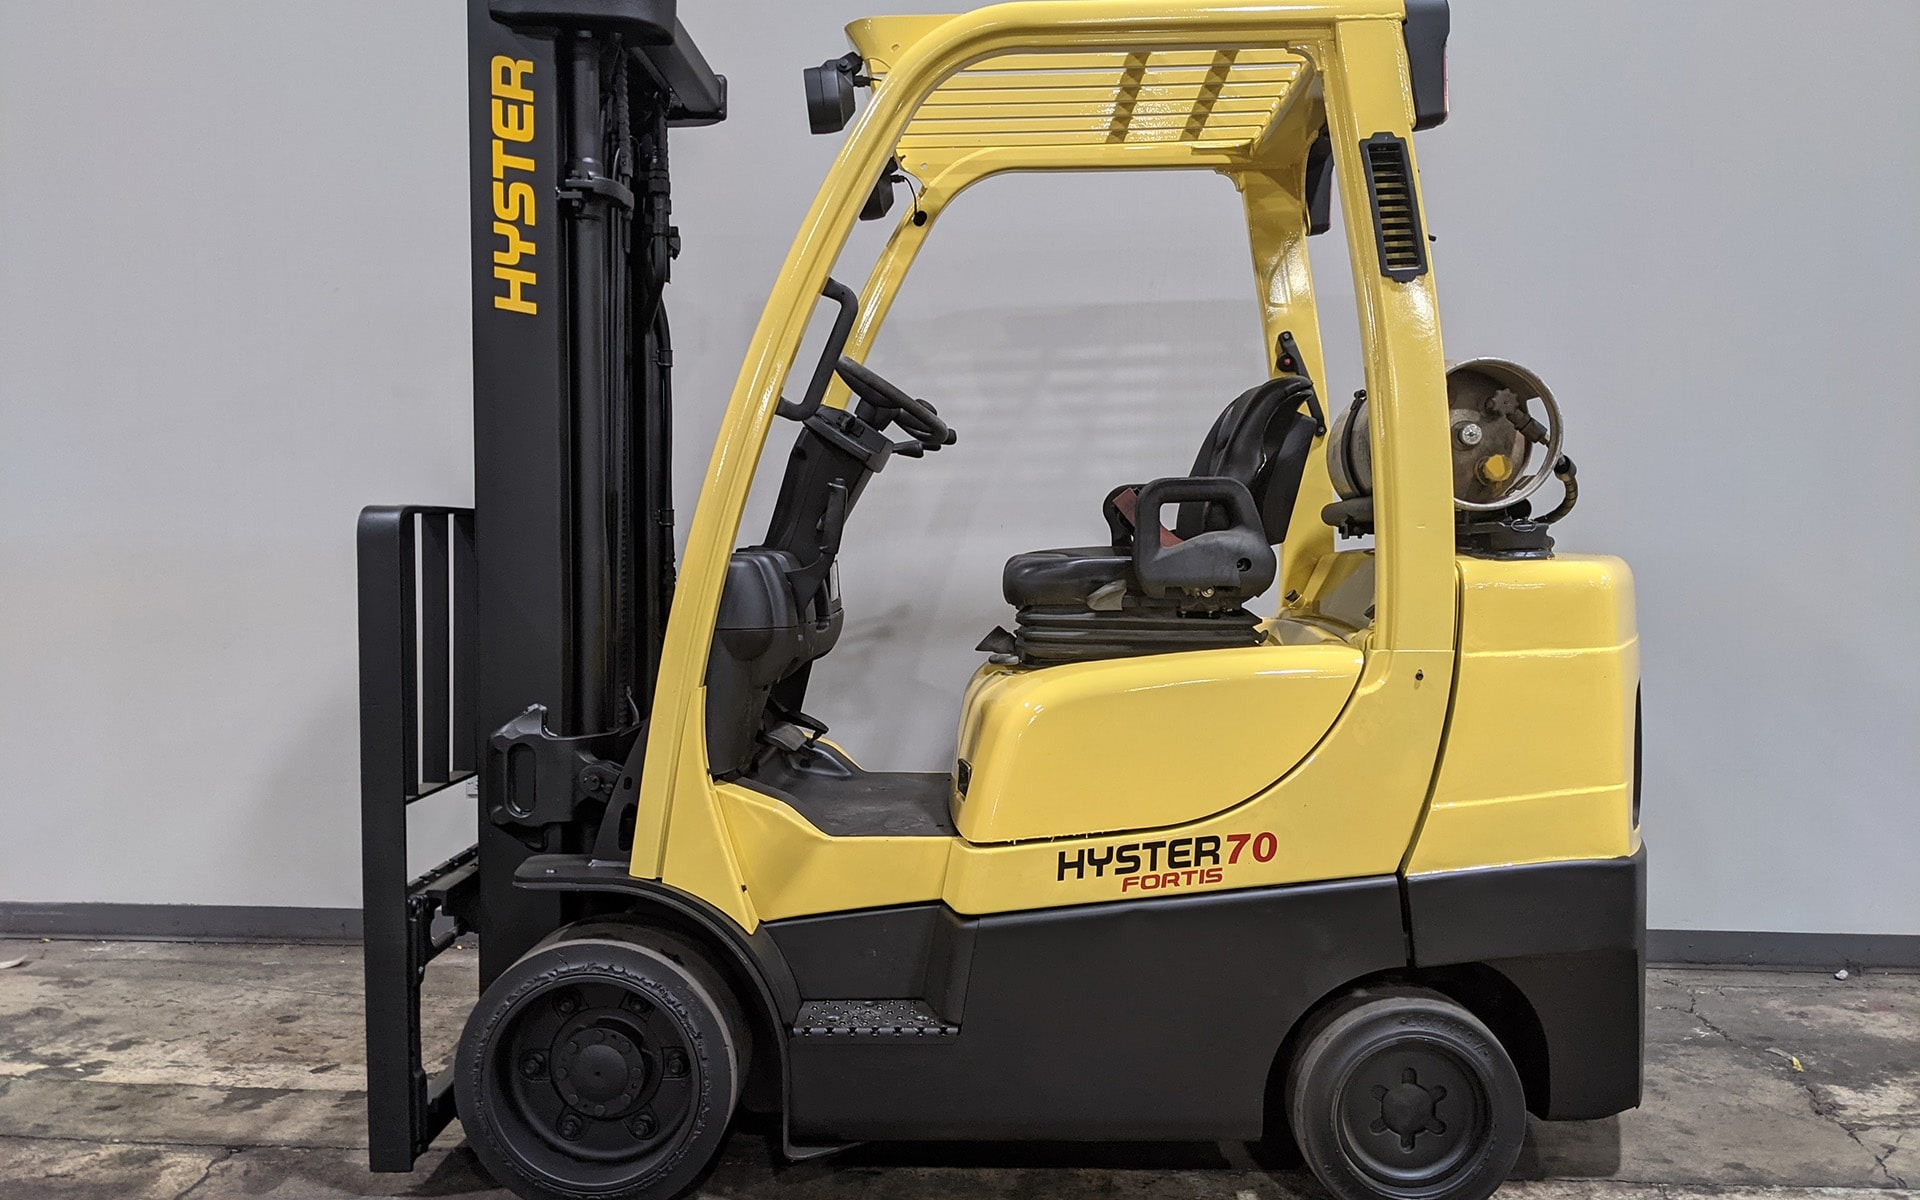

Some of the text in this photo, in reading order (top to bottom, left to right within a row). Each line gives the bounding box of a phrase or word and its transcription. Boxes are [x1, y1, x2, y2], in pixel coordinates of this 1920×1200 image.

[491, 55, 538, 316] HYSTER
[1057, 831, 1278, 882] HYSTER 70
[1121, 867, 1223, 893] FORTIS
